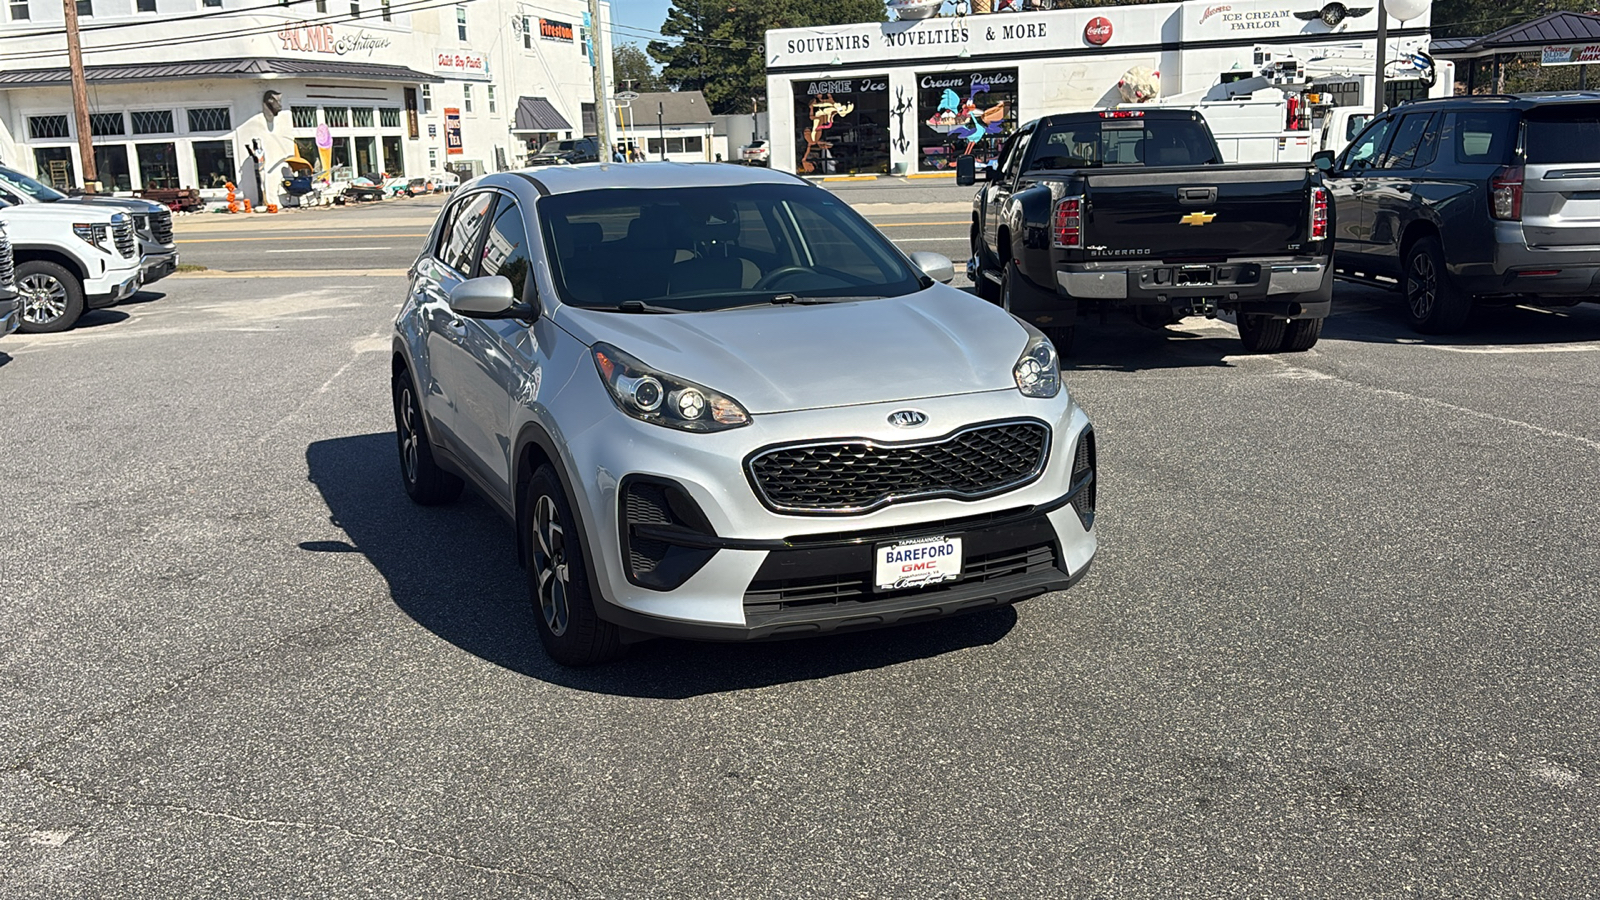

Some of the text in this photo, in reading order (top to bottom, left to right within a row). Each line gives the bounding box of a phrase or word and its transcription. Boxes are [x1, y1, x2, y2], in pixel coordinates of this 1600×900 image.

[1223, 9, 1290, 22] ICE CREAM
[1231, 20, 1280, 30] PARLOR
[278, 20, 335, 54] ACME
[787, 23, 1047, 54] SOUVENIRS NOVELTIES & MORE
[807, 79, 887, 95] ACME Ice
[920, 72, 1016, 89] Cream Parlor
[1090, 248, 1151, 256] SILVERADO
[886, 544, 954, 563] BAREFORD
[902, 561, 937, 572] GMC
